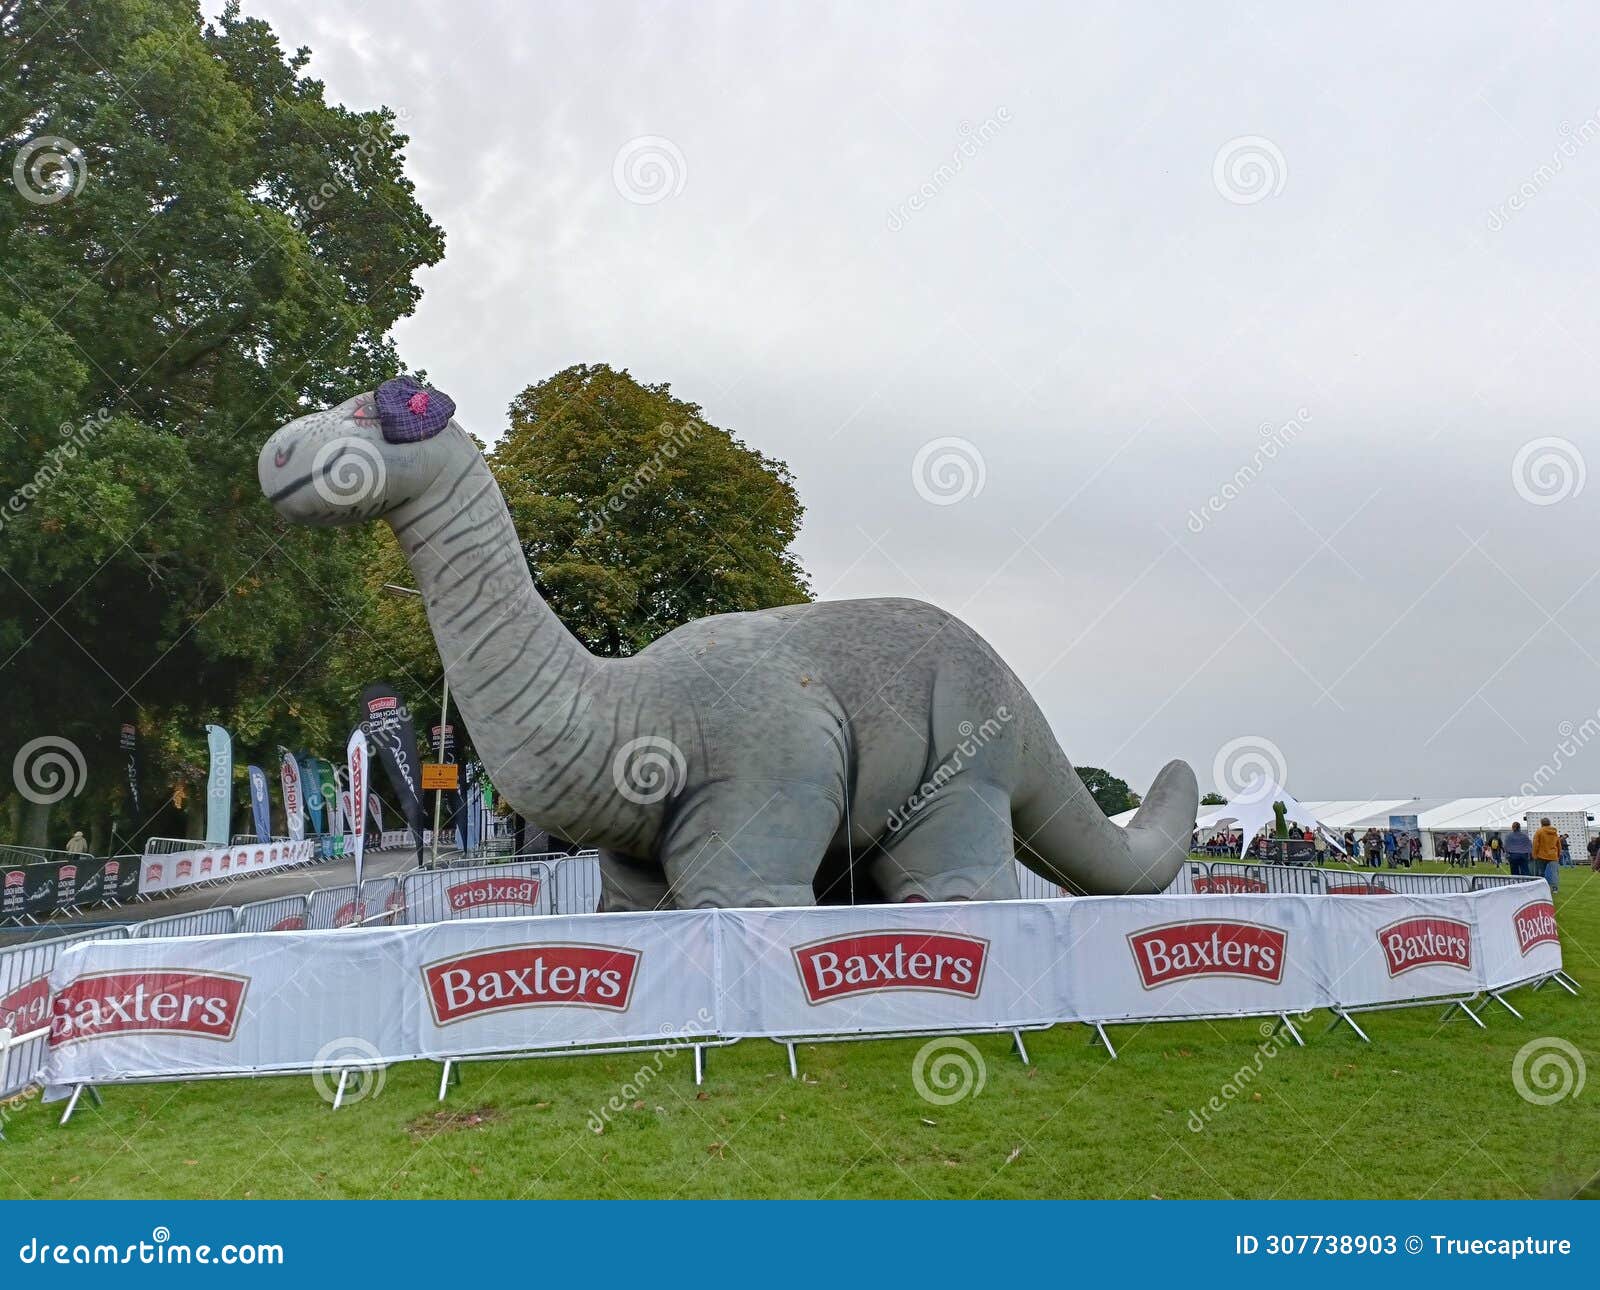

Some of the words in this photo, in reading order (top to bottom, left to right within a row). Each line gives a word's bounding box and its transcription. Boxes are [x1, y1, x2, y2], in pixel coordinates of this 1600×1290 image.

[809, 943, 973, 991] Baxters
[1142, 933, 1275, 976] Baxters
[1387, 926, 1466, 965] Baxters
[441, 955, 622, 1011] Baxters
